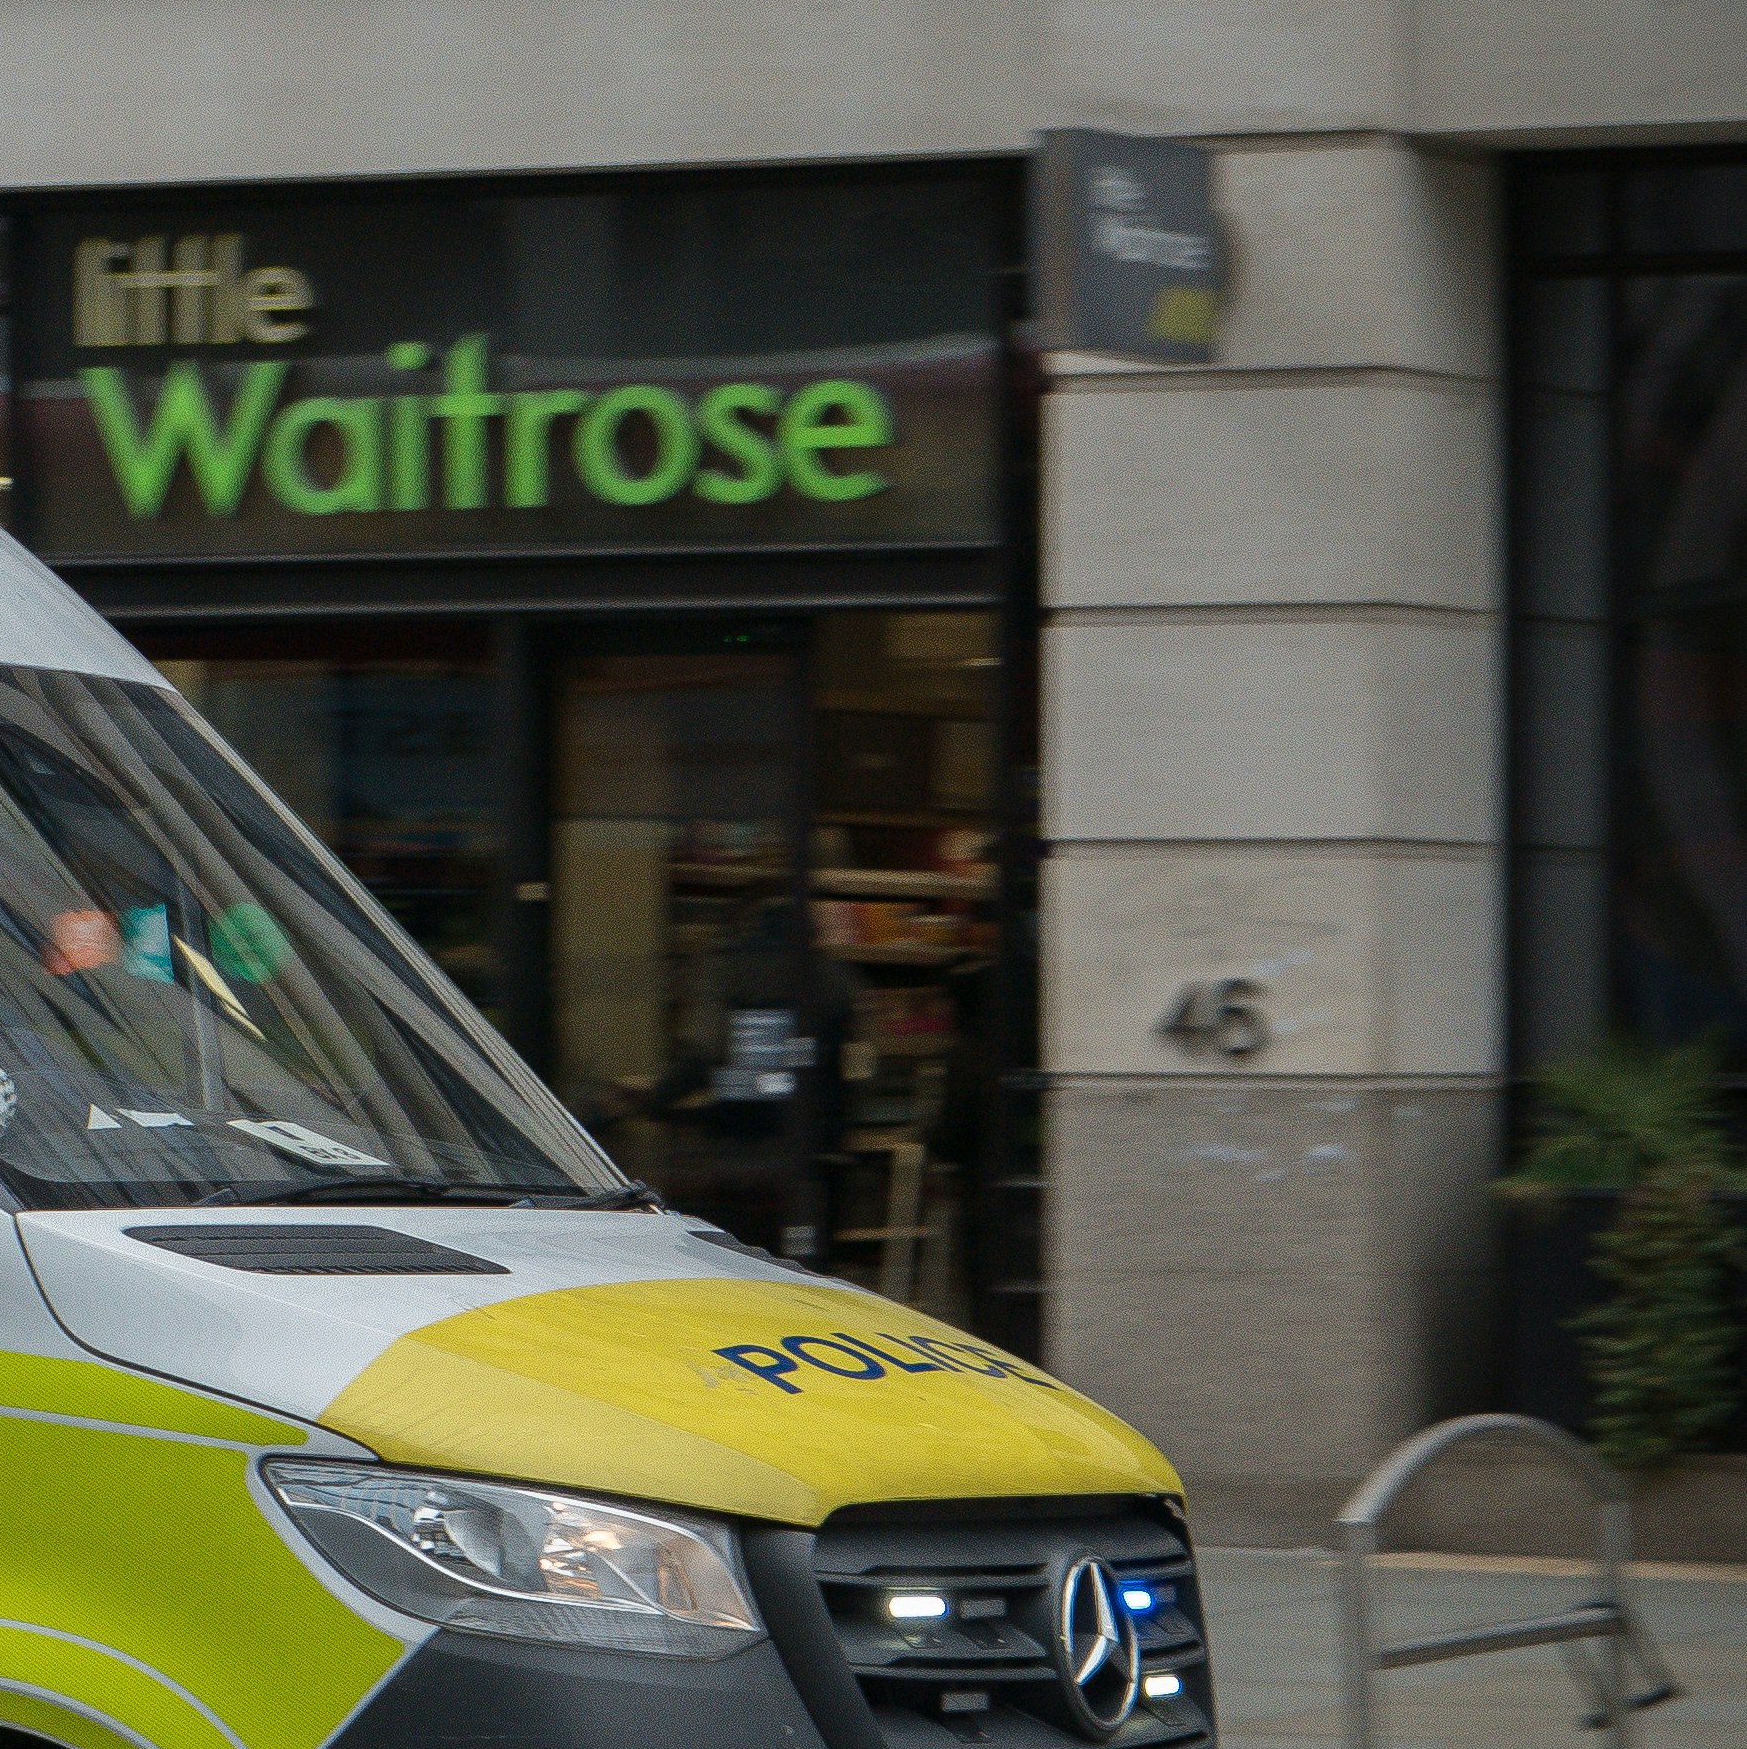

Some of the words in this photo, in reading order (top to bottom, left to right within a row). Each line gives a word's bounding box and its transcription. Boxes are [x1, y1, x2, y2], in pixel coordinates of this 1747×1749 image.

[74, 234, 316, 347] little
[79, 334, 892, 517] Waitrose
[712, 1332, 1061, 1394] POLICE
